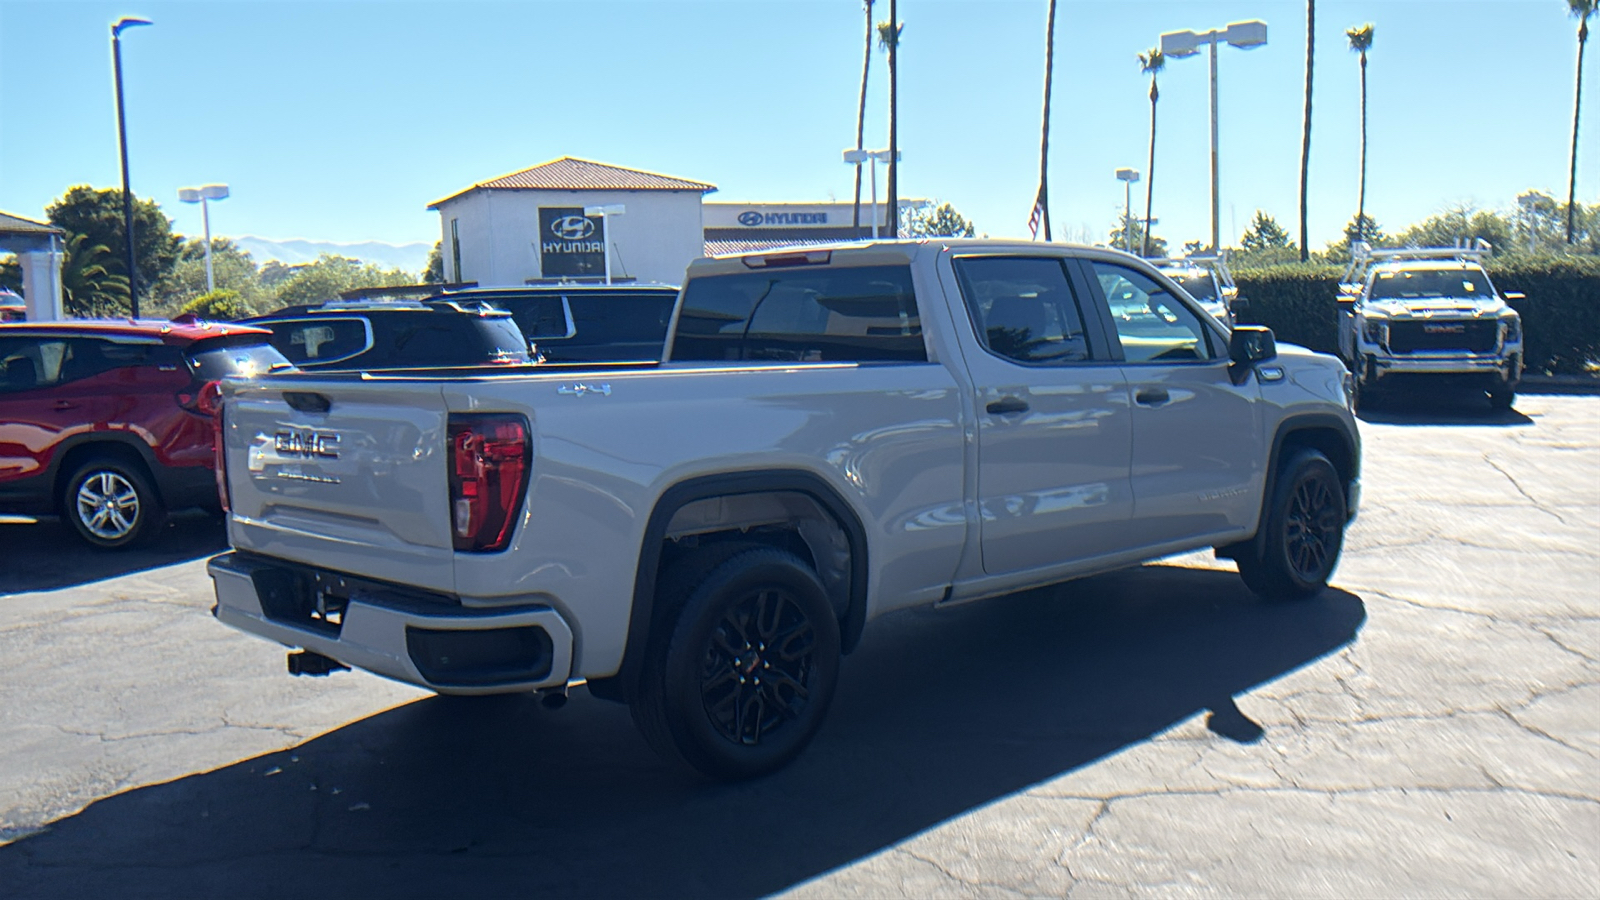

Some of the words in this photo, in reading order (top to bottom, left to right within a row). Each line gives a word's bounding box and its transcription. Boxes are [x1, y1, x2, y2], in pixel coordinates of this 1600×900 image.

[764, 212, 828, 225] HYUNDAI
[542, 241, 605, 254] HYUNDAI
[275, 431, 341, 459] GMC
